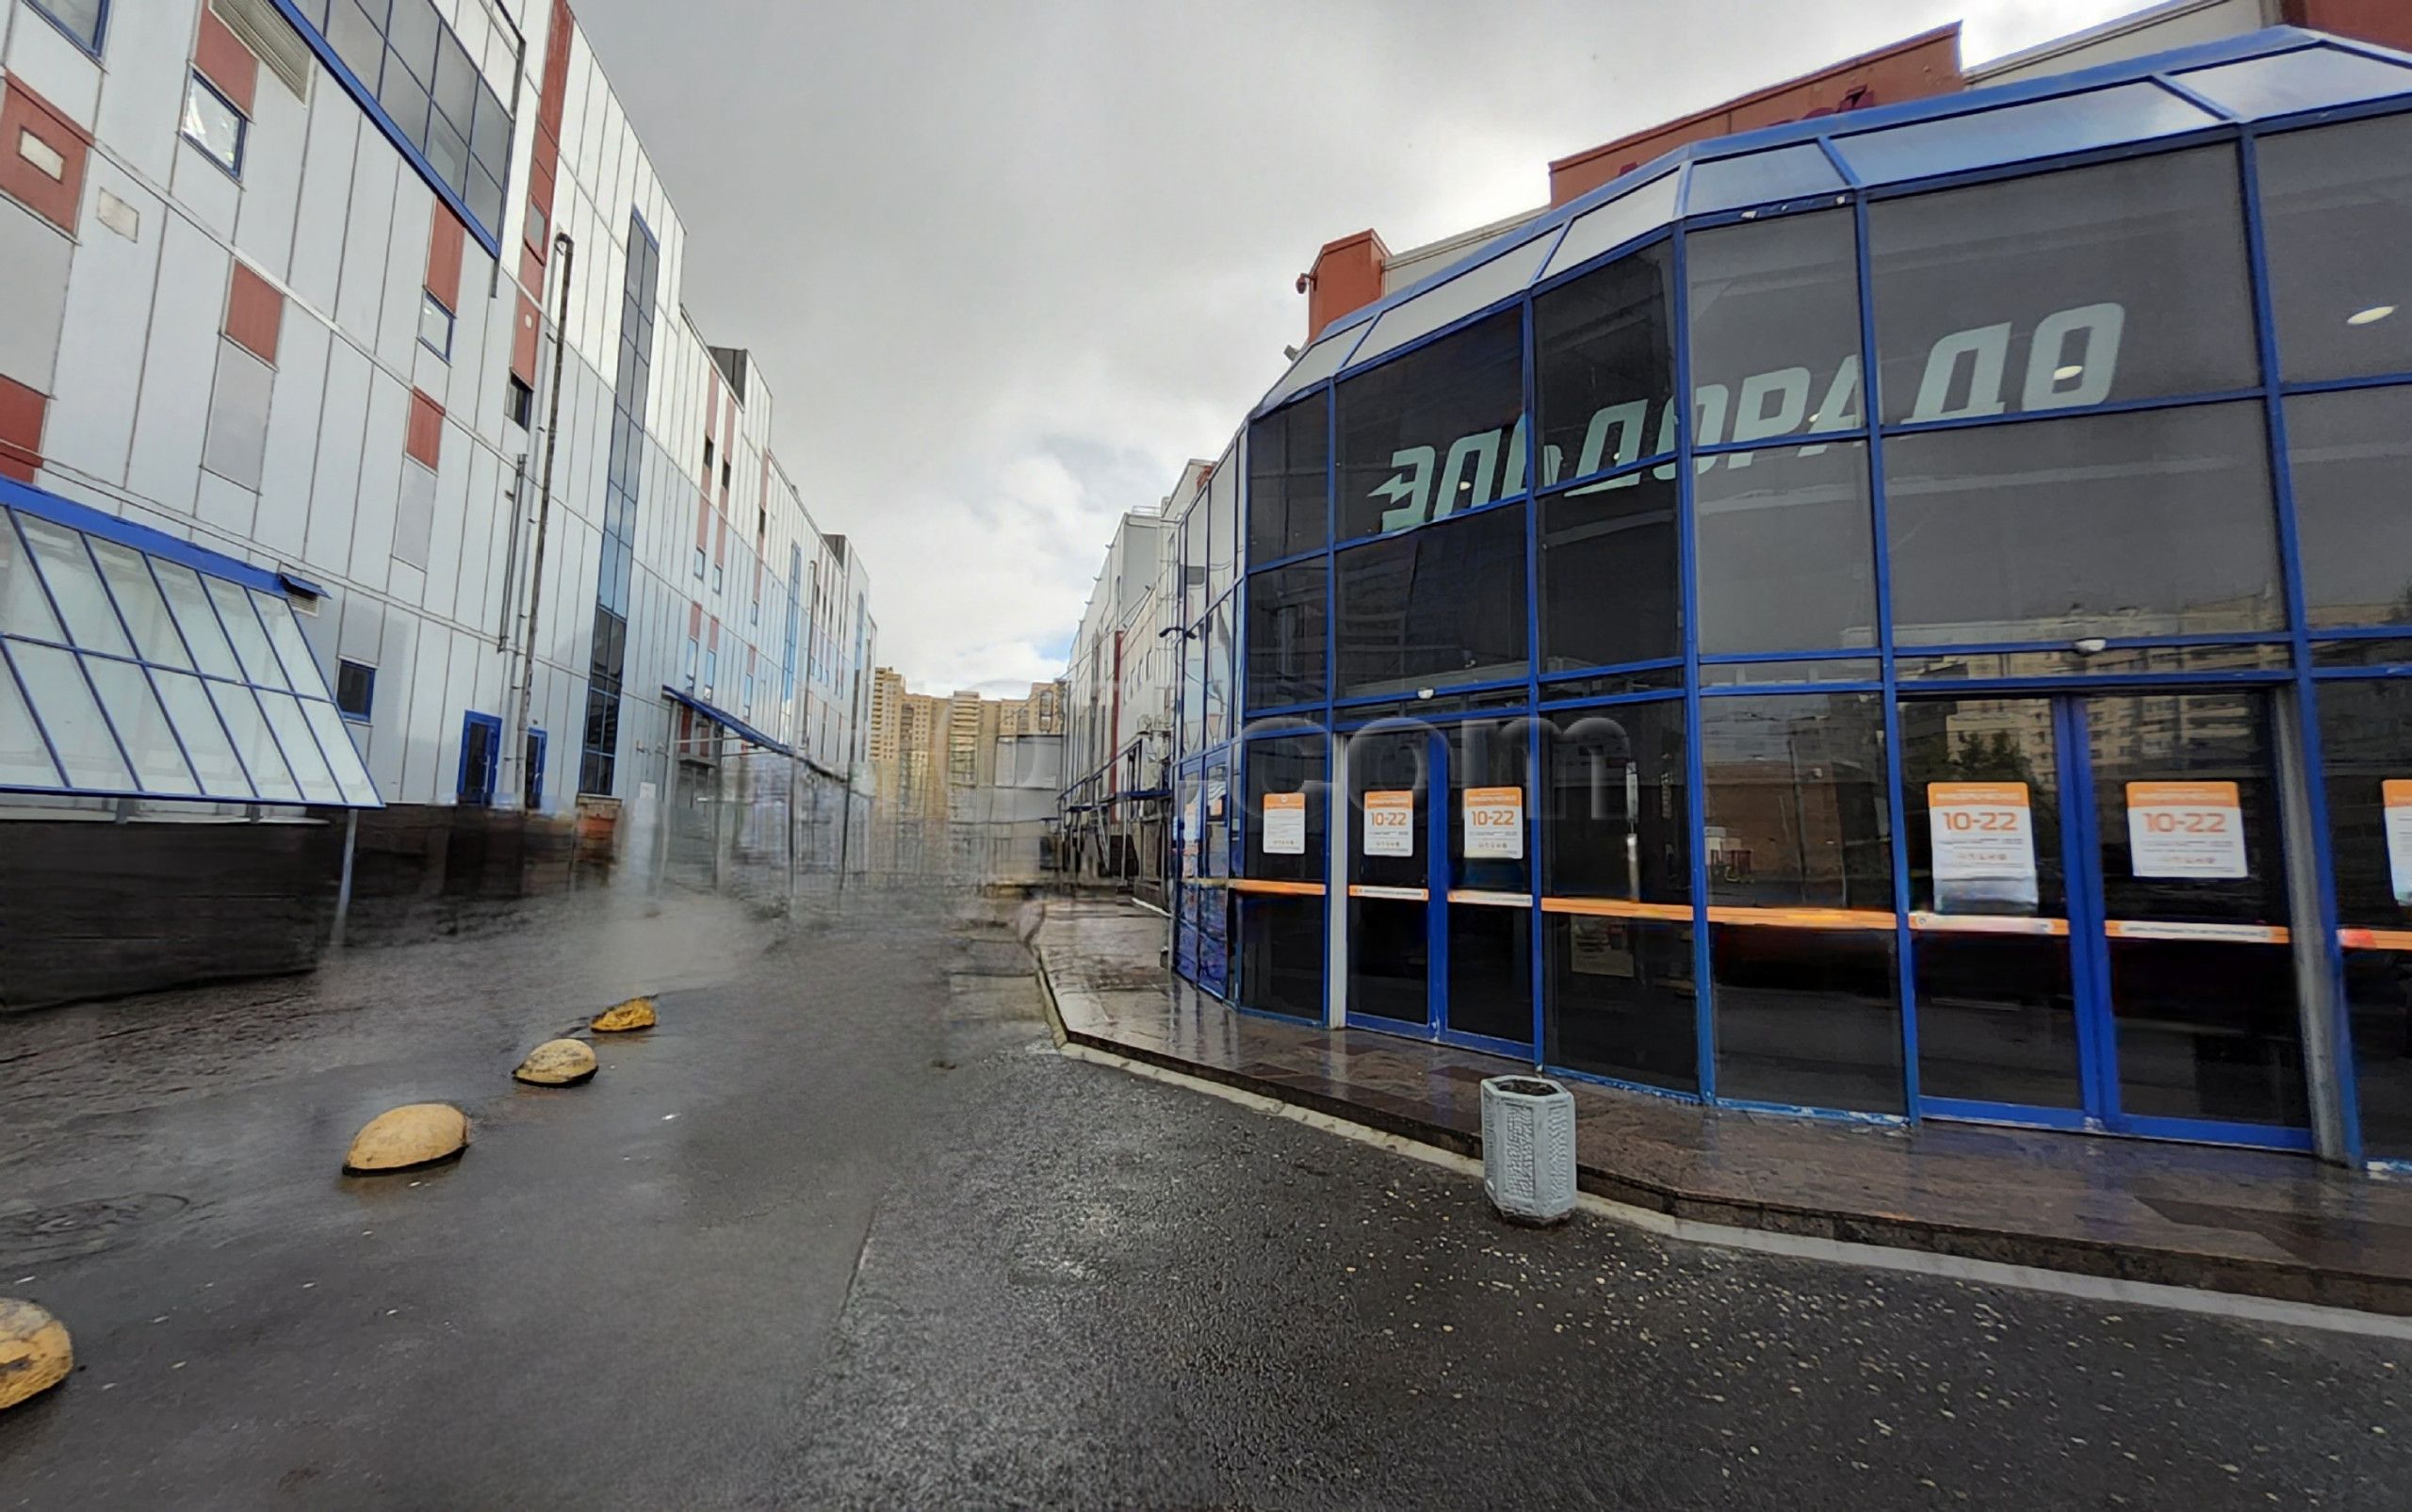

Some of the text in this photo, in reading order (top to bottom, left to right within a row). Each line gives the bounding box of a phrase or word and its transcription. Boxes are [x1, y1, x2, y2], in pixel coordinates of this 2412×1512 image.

[1368, 301, 2127, 534] ЭЛЬДОРАДО
[1371, 811, 1408, 827] 10-22
[1471, 810, 1515, 826] 10-22
[1943, 811, 2018, 831] 10-22
[2143, 812, 2226, 833] 10-22
